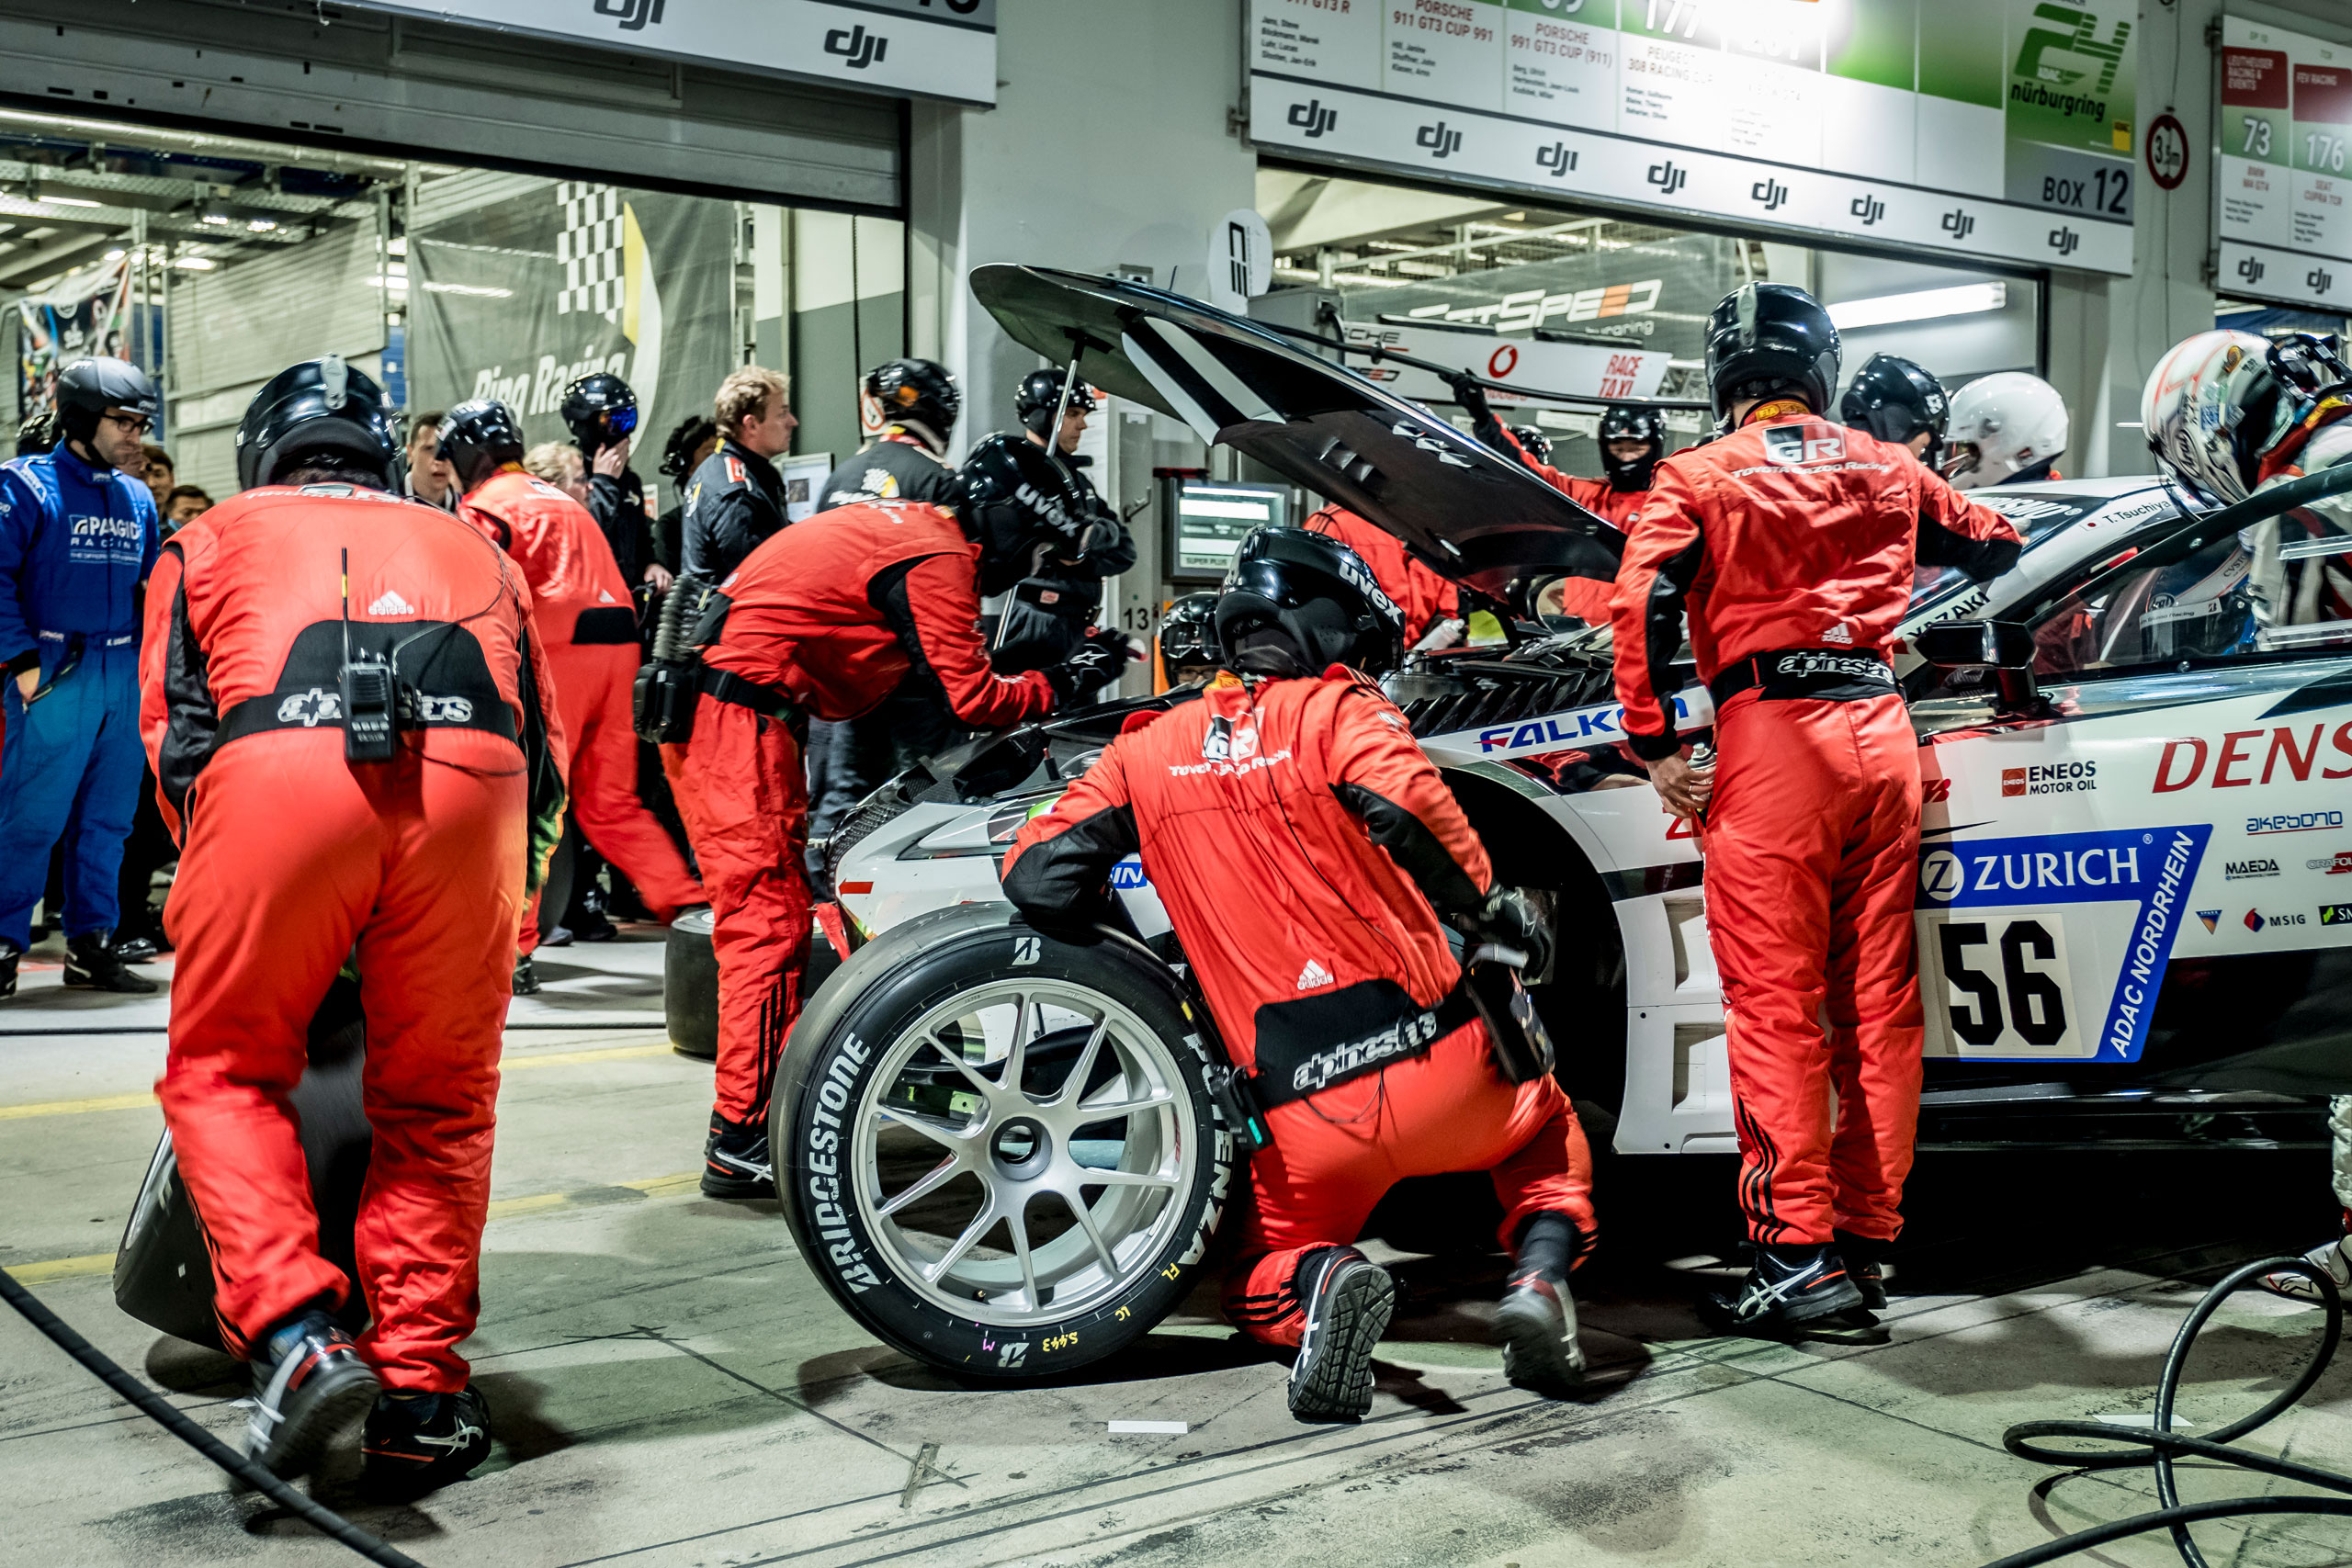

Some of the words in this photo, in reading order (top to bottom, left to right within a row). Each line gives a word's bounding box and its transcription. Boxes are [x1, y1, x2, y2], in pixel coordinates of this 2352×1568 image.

[1416, 0, 1474, 21] PORSCHE
[1394, 10, 1414, 27] 911
[1419, 16, 1442, 32] GT3
[1445, 21, 1470, 37] CUP
[1474, 27, 1493, 42] 991
[1535, 22, 1589, 45] PORSCHE
[1511, 34, 1530, 50] 991
[1534, 39, 1556, 55] GT3
[1559, 44, 1583, 59] CUP
[1586, 49, 1612, 69] (911)
[1628, 58, 1646, 73] 308
[1649, 62, 1690, 81] RACING
[2010, 81, 2106, 123] nürburgring
[2244, 117, 2271, 156] 73
[2306, 133, 2345, 172] 176
[2042, 175, 2086, 209] BOX
[2093, 167, 2130, 215] 12
[1408, 279, 1663, 333] TSPEED
[529, 344, 627, 416] Rain
[1606, 355, 1644, 377] RACE
[1599, 378, 1634, 399] TAXI
[1770, 437, 1841, 463] GR
[1732, 465, 1790, 479] TOYOTA
[1792, 462, 1842, 475] GAZOO
[1845, 461, 1891, 473] Racing
[1015, 482, 1082, 538] uvex
[2117, 500, 2171, 521] Tsuchiya
[1186, 557, 1208, 566] SUPER
[1210, 558, 1227, 566] PLUS
[1339, 561, 1403, 626] uvex
[1124, 607, 1149, 631] 13
[1906, 591, 1991, 638] YZAKI
[1473, 695, 1690, 753] FALK
[2003, 778, 2025, 786] ENEOS
[2029, 760, 2097, 783] ENEOS
[2029, 782, 2074, 795] MOTOR
[2076, 779, 2098, 791] OIL
[1974, 847, 2141, 891] ZURICH
[2225, 858, 2280, 875] MAEDA
[2269, 913, 2307, 927] MSIG
[2109, 984, 2145, 1059] ADAC
[2130, 830, 2195, 986] NORDRHEIN
[1939, 919, 2067, 1046] 56
[809, 1032, 886, 1293] BRIDGESTONE
[1161, 1261, 1181, 1282] FL
